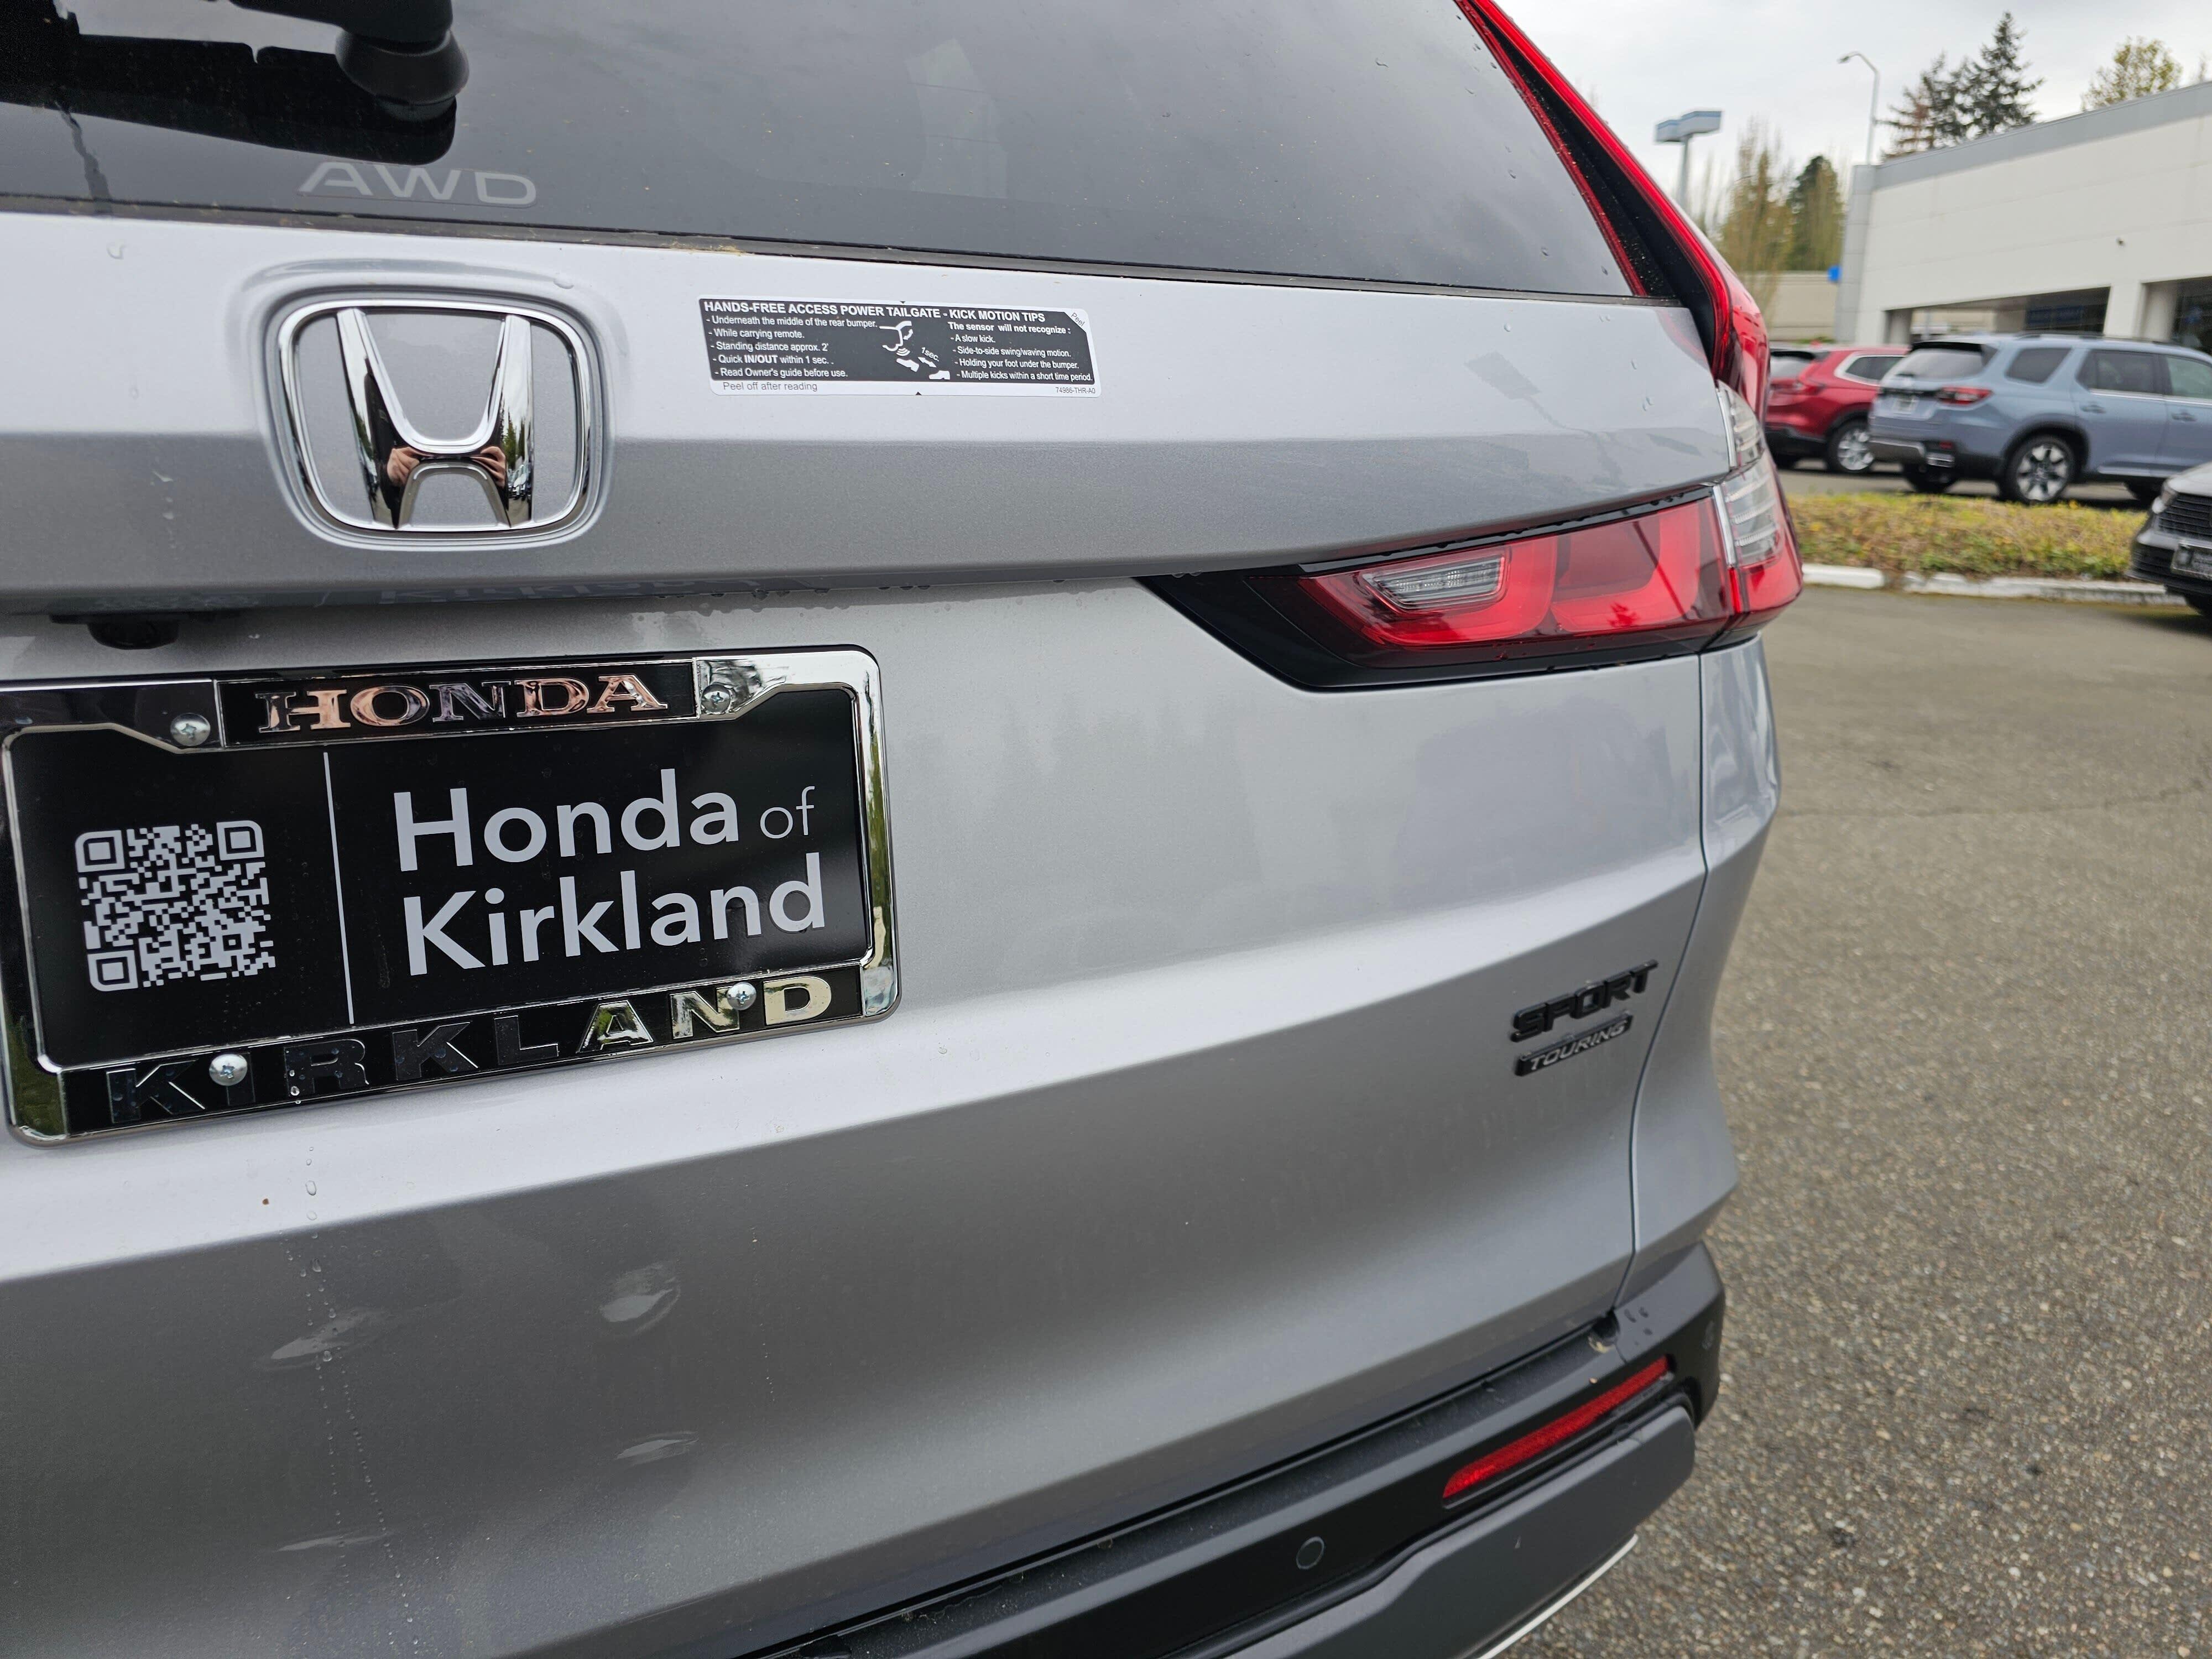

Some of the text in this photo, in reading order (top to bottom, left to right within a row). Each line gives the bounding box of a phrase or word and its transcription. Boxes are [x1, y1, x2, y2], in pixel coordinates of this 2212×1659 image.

[298, 161, 536, 207] AWD
[704, 301, 786, 313] HANDS-FREE
[788, 304, 838, 315] ACCESS
[840, 305, 885, 316] POWER
[886, 307, 941, 318] TAILGATE
[949, 309, 977, 320] KICK
[978, 310, 1020, 321] MOTION
[1021, 312, 1046, 322] TIPS
[712, 315, 760, 325] Underneath
[762, 316, 775, 325] the
[777, 317, 804, 325] middle
[805, 317, 813, 326] of
[815, 318, 827, 326] the
[846, 319, 877, 328] bumper.
[947, 321, 964, 330] The
[1071, 312, 1085, 327] Peel
[713, 328, 738, 337] While
[740, 329, 773, 339] carrying
[979, 335, 995, 343] kick.
[716, 341, 753, 352] Standing
[755, 342, 789, 351] distance
[791, 343, 820, 352] approx.
[957, 346, 1000, 355] Side-to-side
[1001, 347, 1046, 358] swing/waving
[718, 354, 743, 363] Quick
[744, 354, 778, 363] IN/OUT
[780, 355, 804, 363] within
[959, 358, 987, 368] Holding
[987, 360, 1003, 368] your
[1052, 361, 1079, 370] bumper.
[720, 368, 743, 376] Read
[744, 368, 778, 377] Owner's
[780, 368, 802, 378] guide
[804, 368, 830, 377] before
[961, 371, 989, 380] Multiple
[1071, 373, 1093, 382] period.
[723, 382, 817, 392] Peel off after reading
[257, 673, 667, 734] HONDA
[394, 768, 816, 872] Honda of
[404, 854, 825, 977] Kirkland
[1510, 959, 1658, 1042] SPORT
[1530, 1020, 1627, 1070] TOURING
